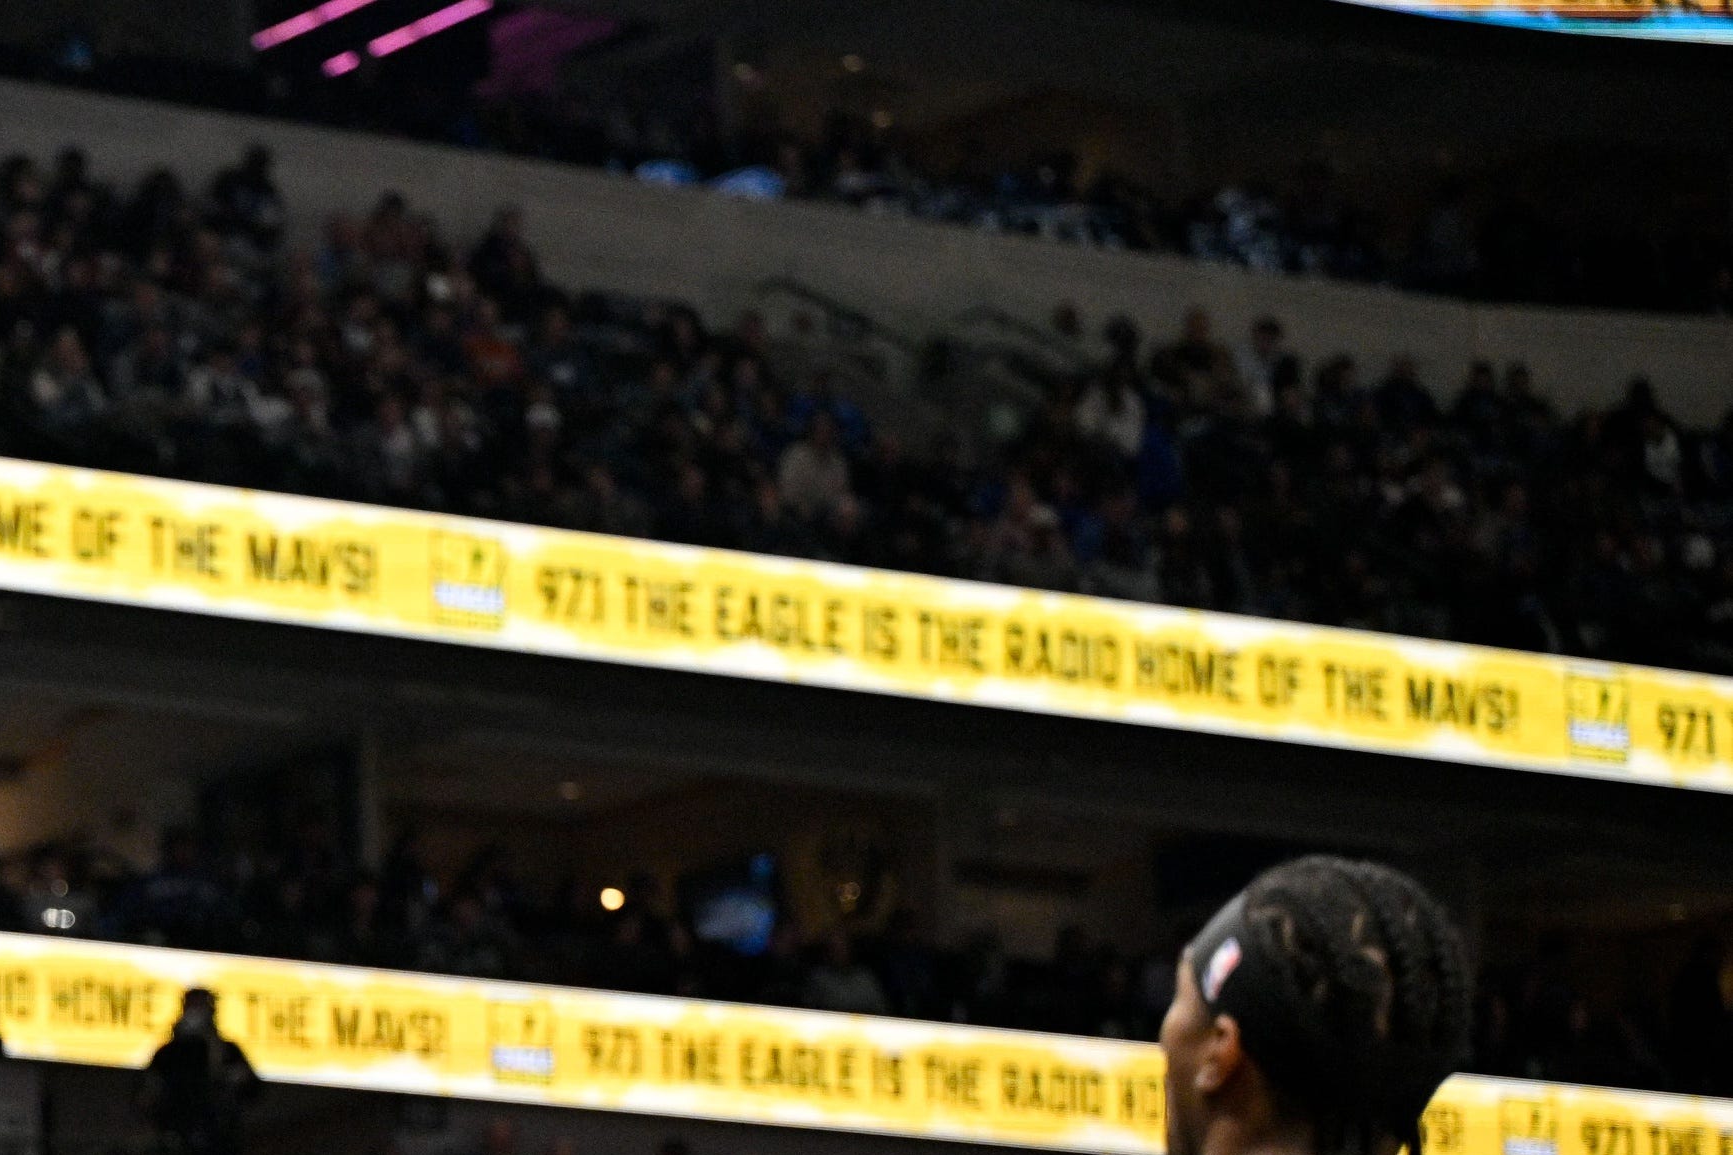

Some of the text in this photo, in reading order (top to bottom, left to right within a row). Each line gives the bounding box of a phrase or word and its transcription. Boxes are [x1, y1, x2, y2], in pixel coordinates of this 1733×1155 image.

[72, 507, 122, 564] OF
[148, 516, 222, 582] THE
[536, 565, 605, 623] 971
[623, 574, 697, 640] THE
[713, 585, 846, 655] EAGLE
[861, 604, 900, 665] IS
[917, 609, 989, 676] THE
[1004, 620, 1120, 690] RADIO
[1133, 640, 1241, 705] HOME
[1256, 651, 1302, 710] OF
[1321, 661, 1388, 722] THE
[1657, 703, 1716, 761] 971
[51, 976, 160, 1036] HOME
[245, 990, 311, 1048] THE
[581, 1023, 644, 1079] 971
[657, 1029, 725, 1086] THE
[738, 1036, 858, 1099] EAGLE
[869, 1050, 906, 1101] IS
[921, 1052, 985, 1112] THE
[1000, 1061, 1105, 1120] RADIO
